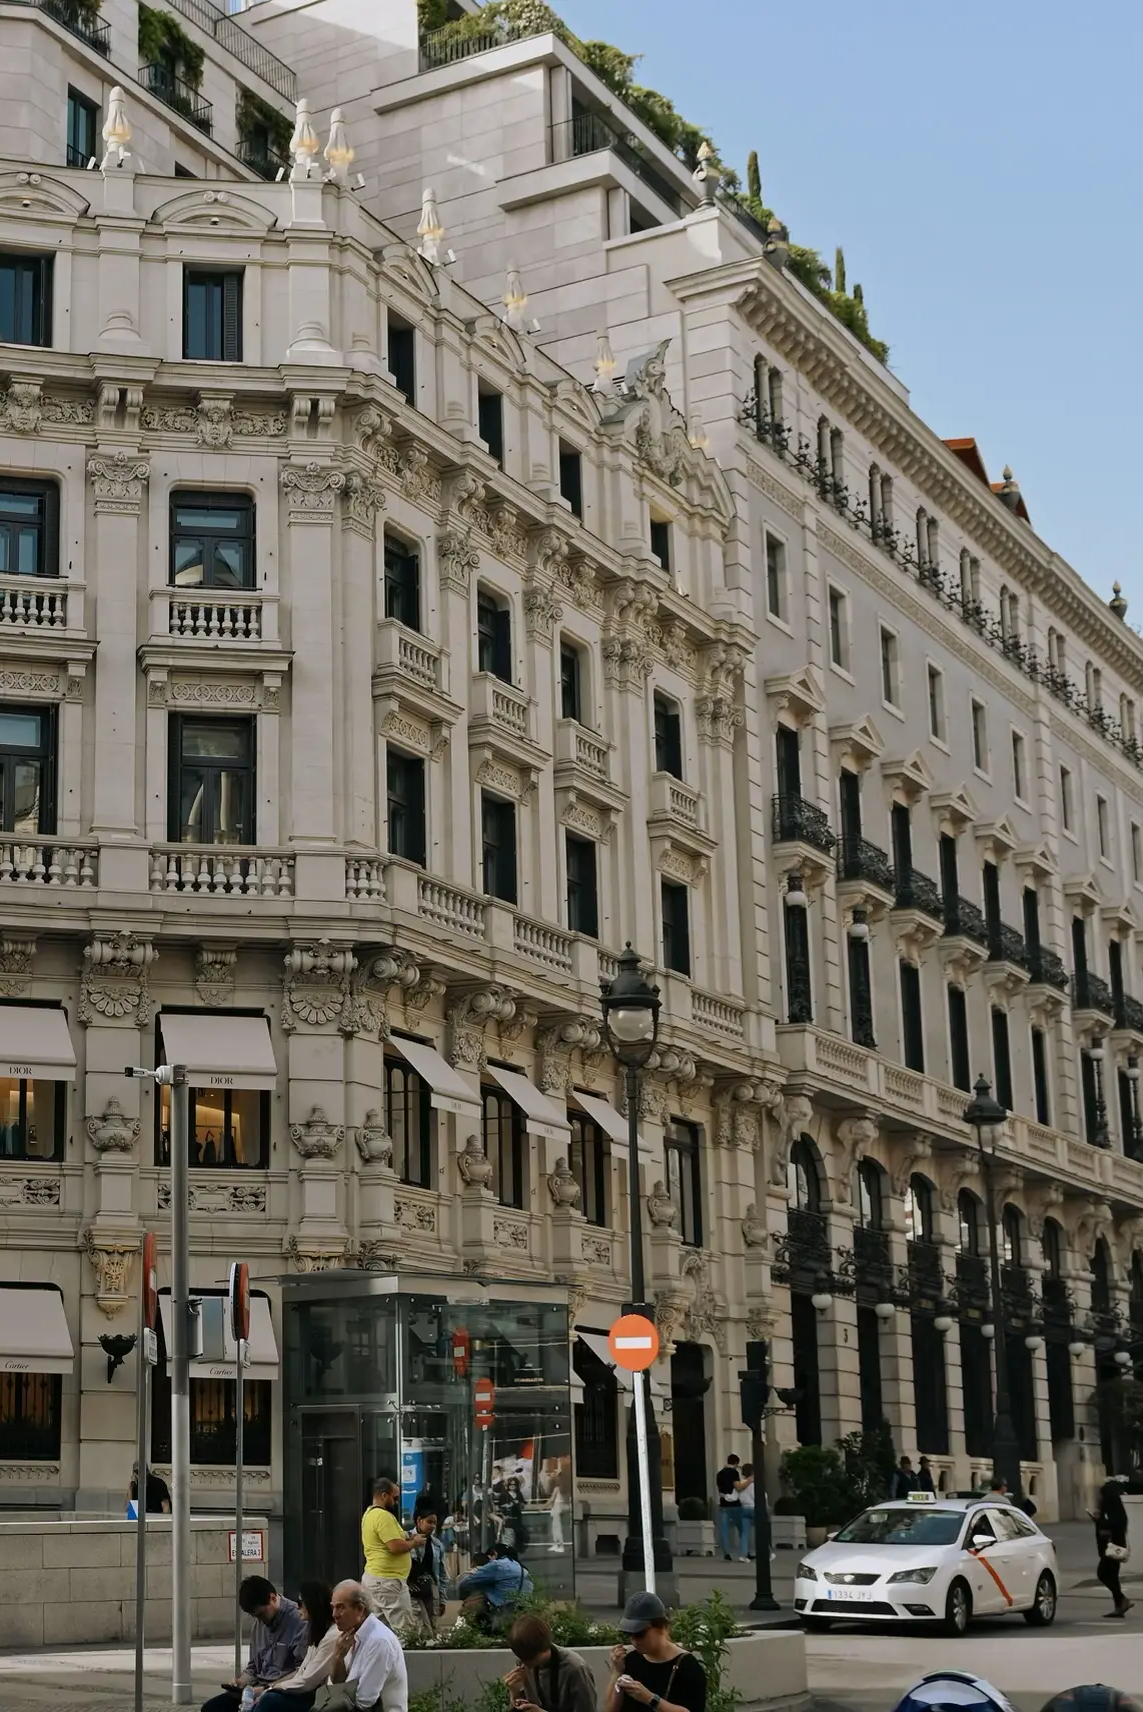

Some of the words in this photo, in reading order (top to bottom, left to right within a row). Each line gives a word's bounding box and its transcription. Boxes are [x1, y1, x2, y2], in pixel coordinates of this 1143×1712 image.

[9, 1066, 32, 1075] DIOR
[210, 1076, 233, 1085] DIOR
[4, 1360, 29, 1369] Cartier
[209, 1366, 234, 1375] Cartier
